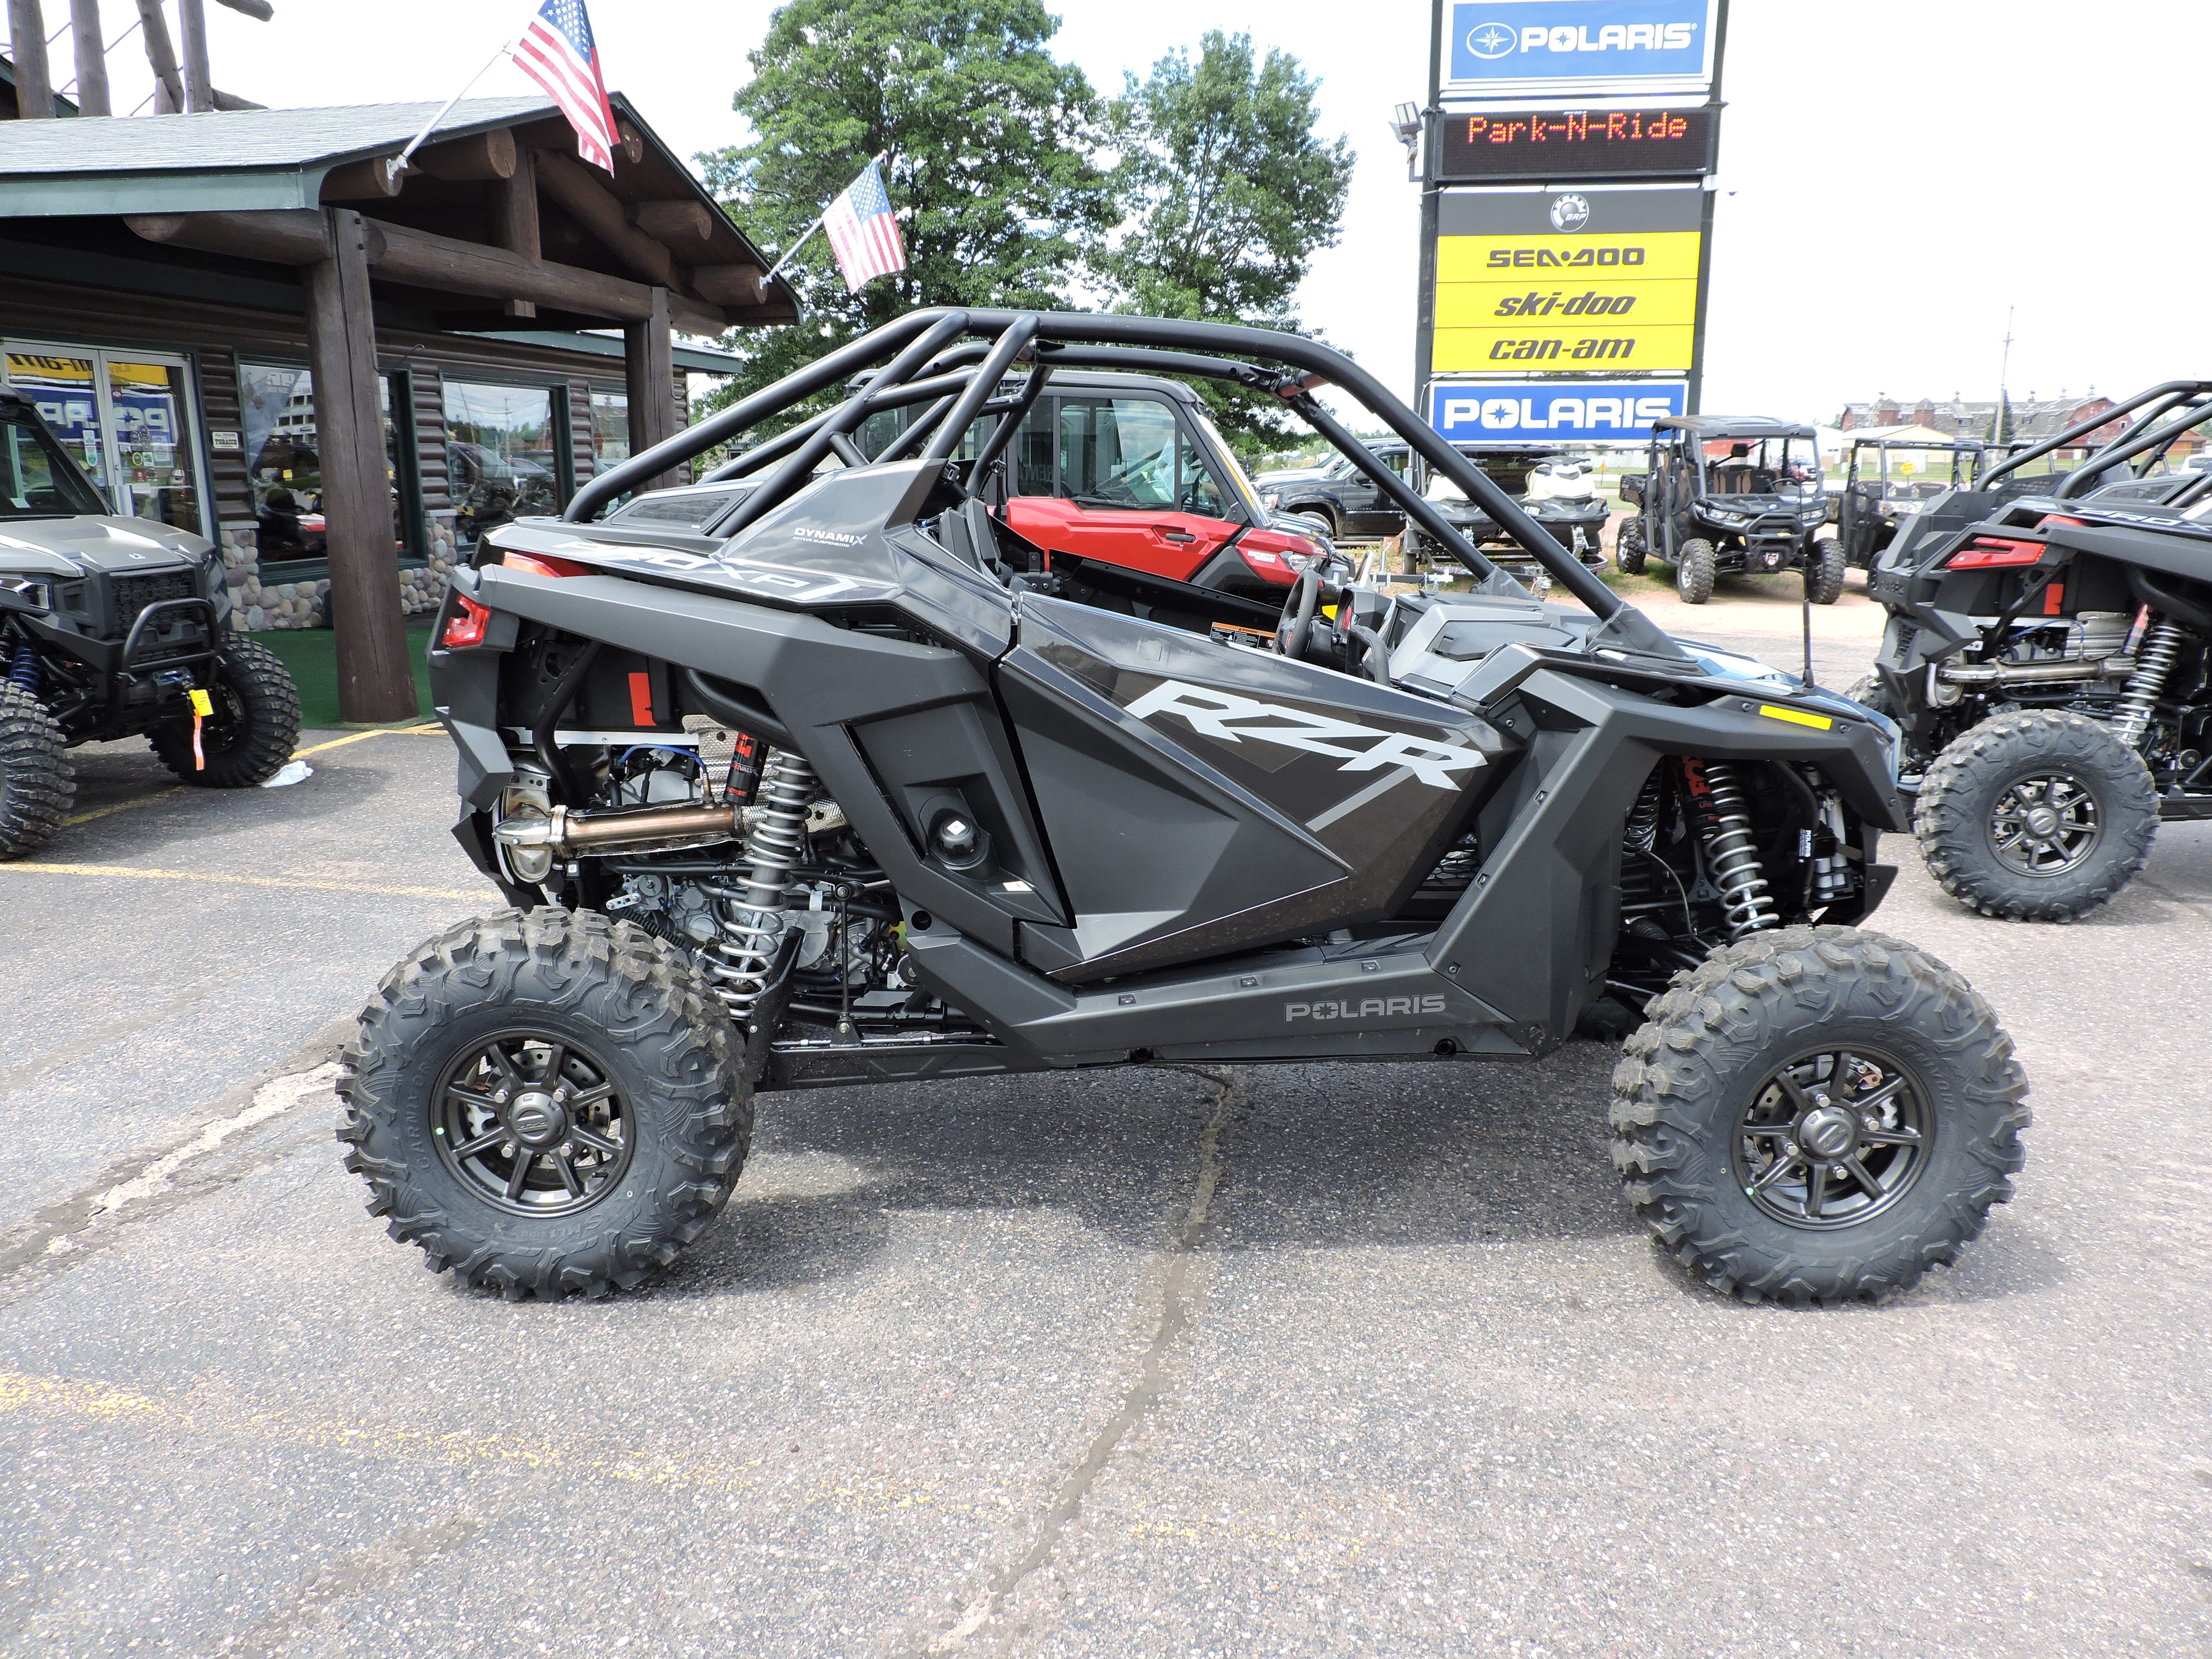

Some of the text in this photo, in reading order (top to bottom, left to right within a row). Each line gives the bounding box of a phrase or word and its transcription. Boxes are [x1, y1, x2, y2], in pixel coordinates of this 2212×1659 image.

[1520, 23, 1691, 53] POLARIS
[1468, 111, 1687, 144] Park-N-Ride
[1565, 213, 1587, 221] BRP
[1494, 291, 1636, 316] ski-doo
[1489, 338, 1635, 360] can-am
[1444, 397, 1671, 429] POLARIS
[794, 528, 867, 546] DYNAMIX
[813, 539, 850, 548] SUSPENSION
[552, 541, 711, 570] PRO
[1123, 680, 1488, 791] RZR
[1285, 993, 1446, 1022] POLARIS
